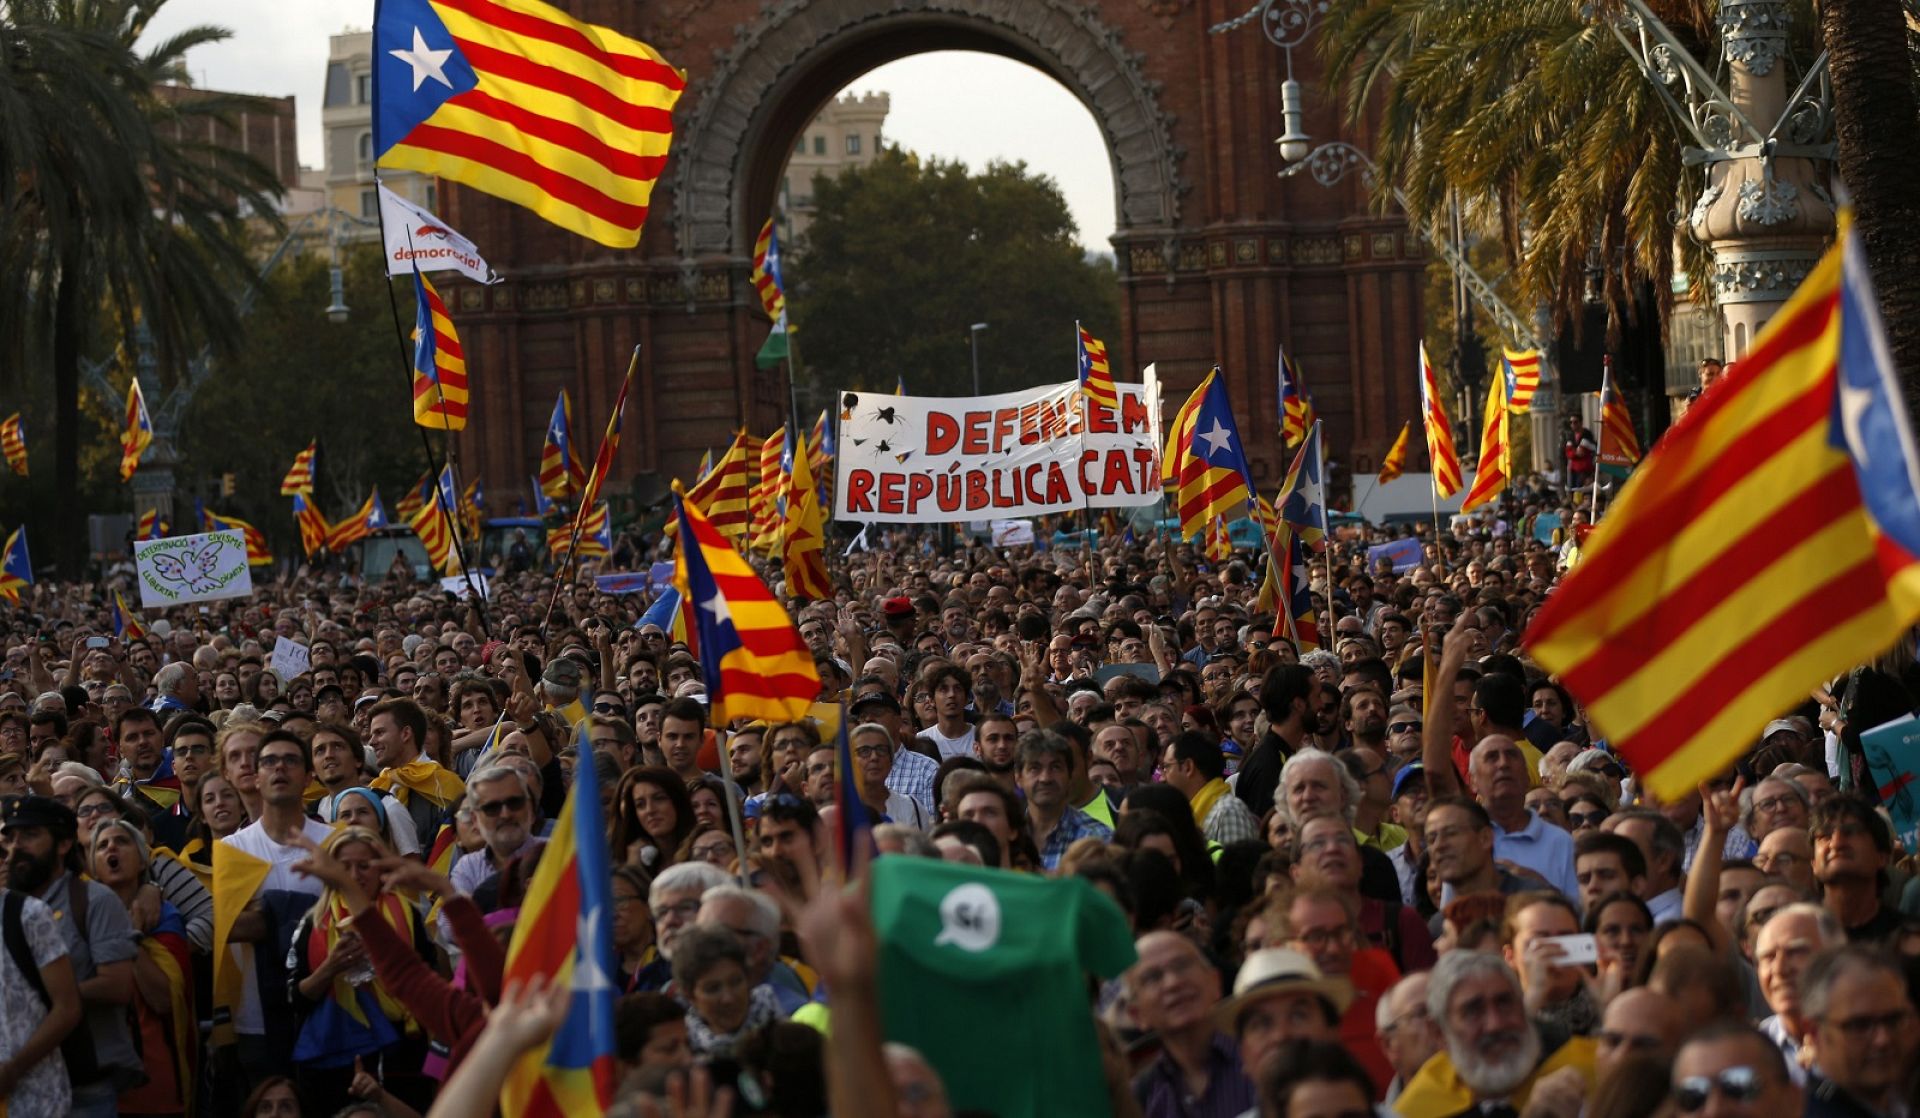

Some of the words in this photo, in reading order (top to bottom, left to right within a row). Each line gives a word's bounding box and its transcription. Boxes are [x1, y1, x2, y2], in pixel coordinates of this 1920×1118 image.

[926, 391, 1150, 455] DEFENSEM
[847, 461, 1072, 514] REPÚBLICA
[208, 532, 244, 551] CIVISME
[142, 570, 180, 600] LLIBERTAT
